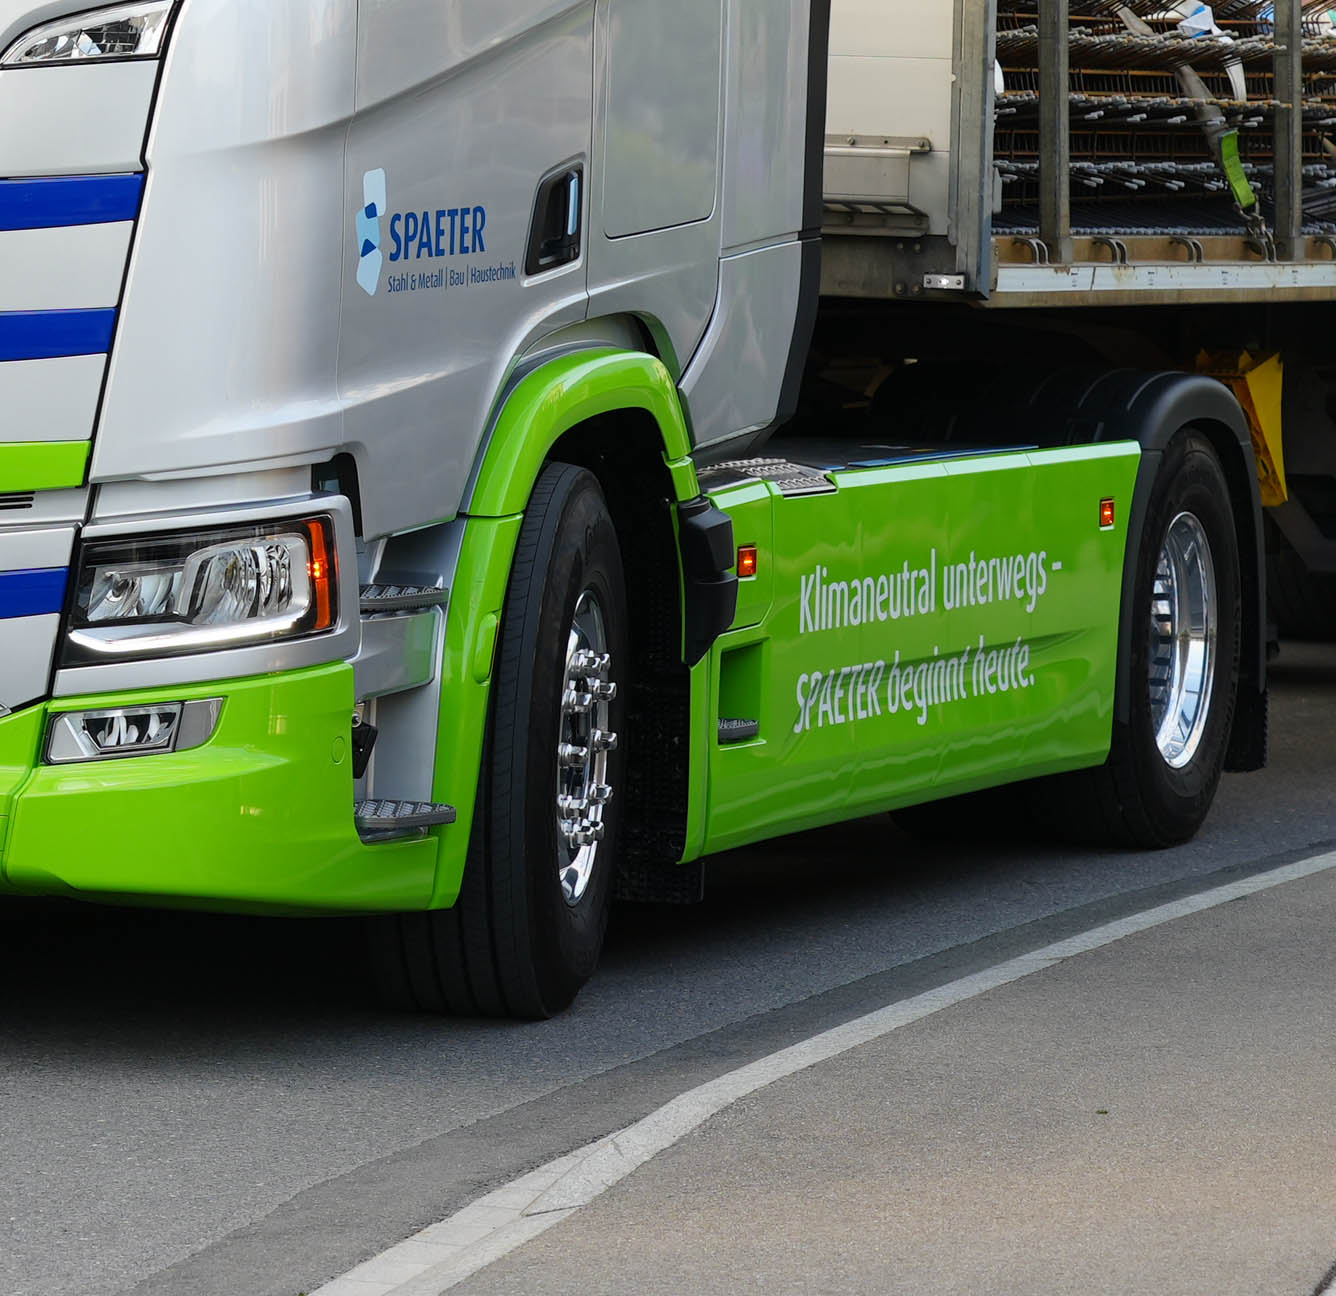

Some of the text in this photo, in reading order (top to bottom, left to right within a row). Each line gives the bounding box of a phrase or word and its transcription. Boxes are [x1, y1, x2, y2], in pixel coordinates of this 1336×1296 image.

[389, 205, 486, 261] SPAETER
[388, 274, 410, 293] Stahl
[410, 276, 416, 289] &
[418, 269, 444, 289] Metall
[450, 270, 464, 287] Bau
[470, 262, 516, 283] Haustechnik
[799, 548, 936, 633] Klimaneutral
[943, 550, 1047, 613] unterwegs
[793, 634, 1036, 734] SPAETER beginnt heute.
